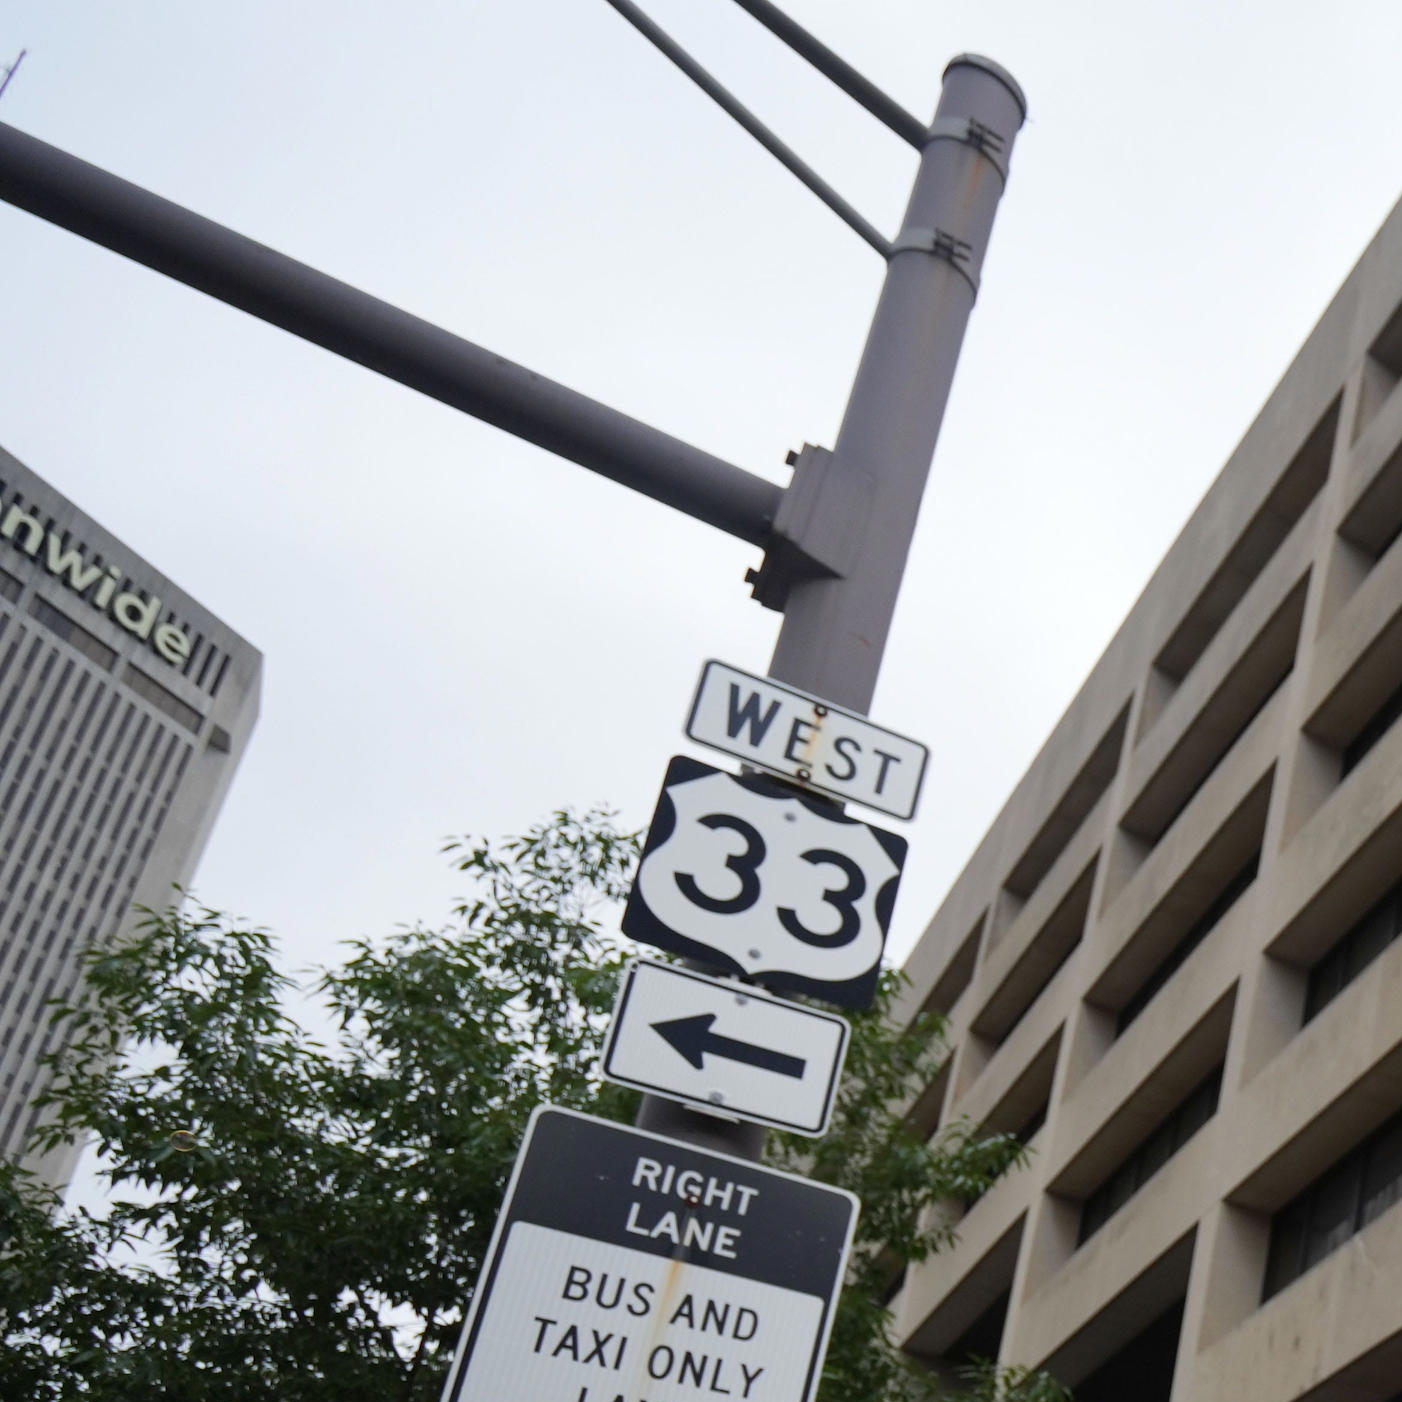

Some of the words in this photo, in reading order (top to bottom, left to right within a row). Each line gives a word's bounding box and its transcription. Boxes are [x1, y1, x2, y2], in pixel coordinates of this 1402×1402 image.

[0, 502, 192, 665] nwide
[724, 681, 902, 795] WEST
[673, 812, 867, 949] 33
[631, 1156, 759, 1216] RIGHT
[625, 1201, 743, 1259] LANE
[561, 1265, 656, 1317] BUS
[669, 1293, 759, 1342] AND
[532, 1316, 628, 1372] TAXI
[647, 1344, 764, 1400] ONLY
